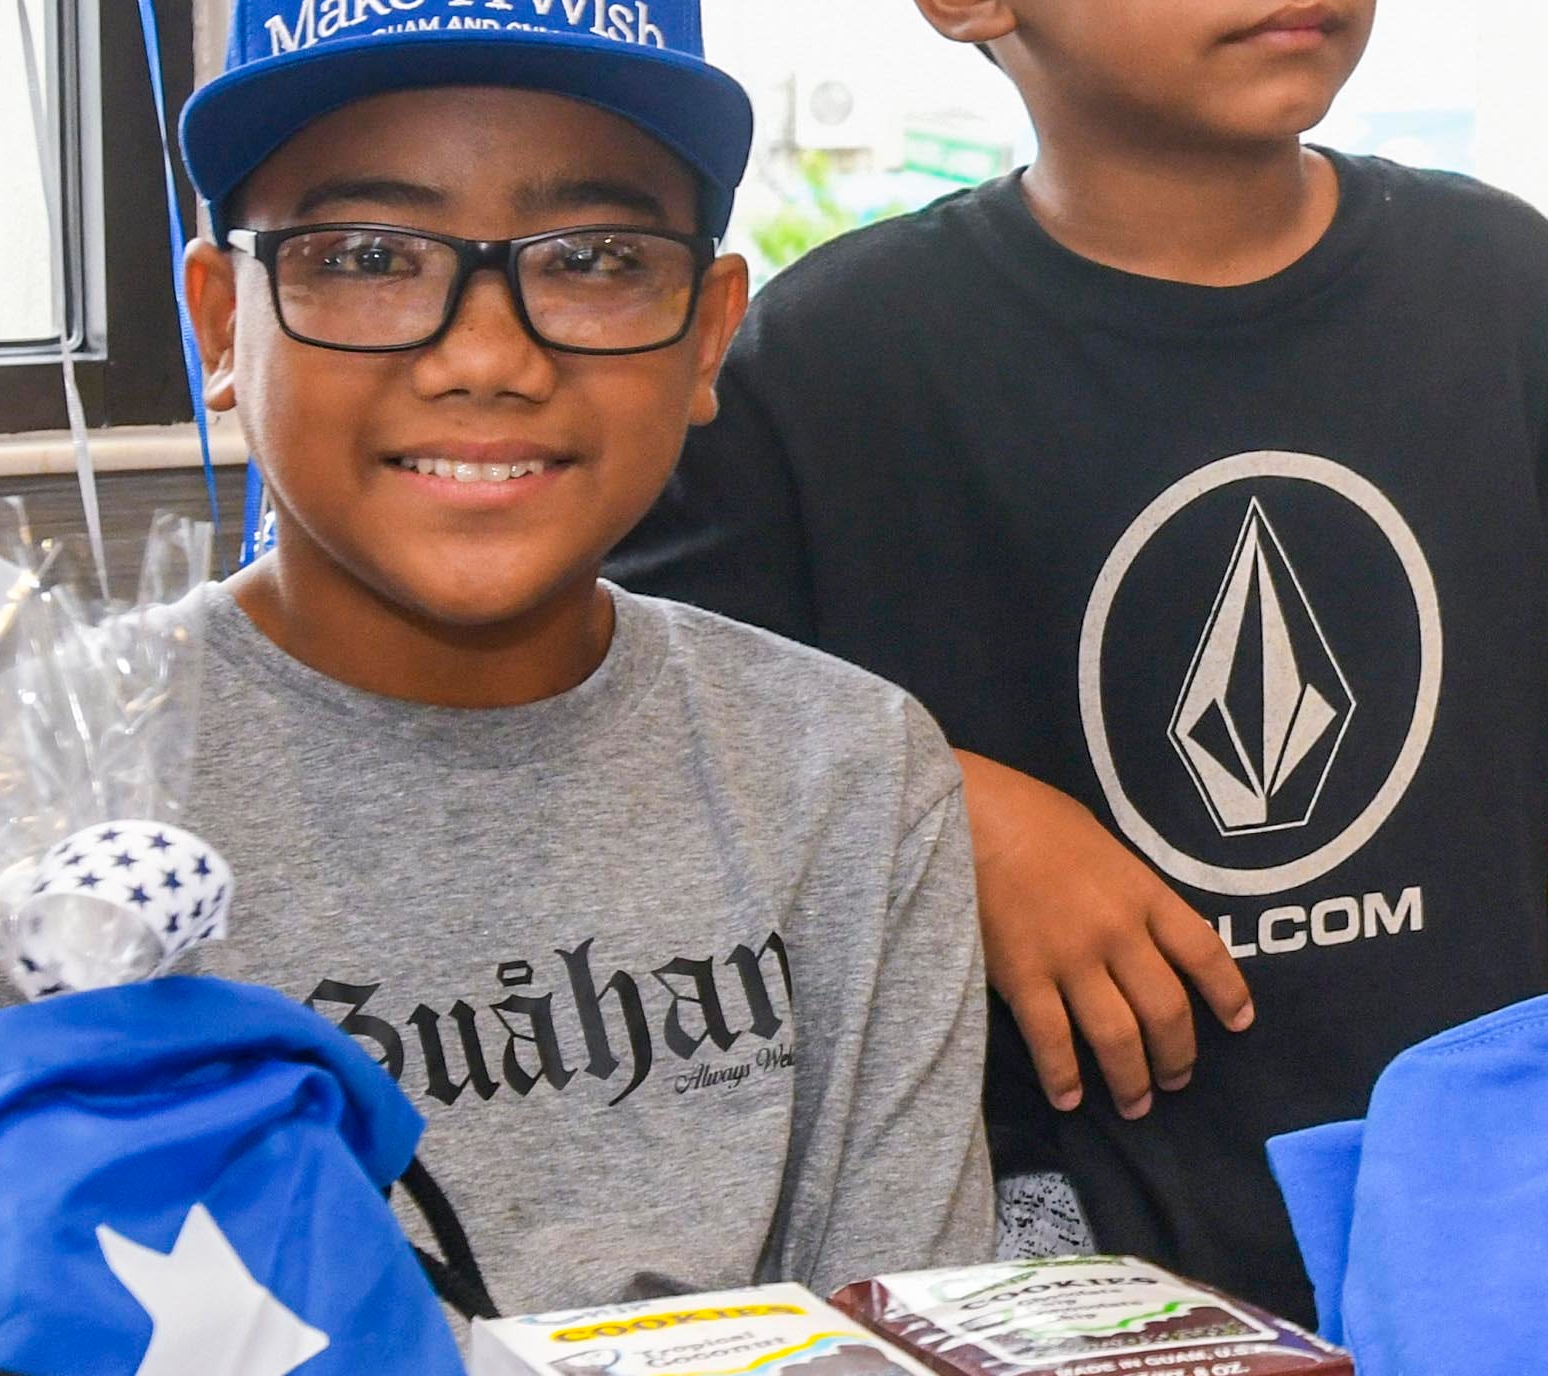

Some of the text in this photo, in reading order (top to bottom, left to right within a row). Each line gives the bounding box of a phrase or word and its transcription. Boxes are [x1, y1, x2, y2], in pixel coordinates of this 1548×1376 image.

[1207, 886, 1424, 959] LCOM
[675, 1063, 751, 1095] Always
[960, 1277, 1158, 1311] COOKIES
[554, 1304, 804, 1342] COOKIES
[642, 1330, 755, 1360] Tropical
[1118, 1357, 1142, 1370] IN
[1211, 1361, 1251, 1376] OZ.
